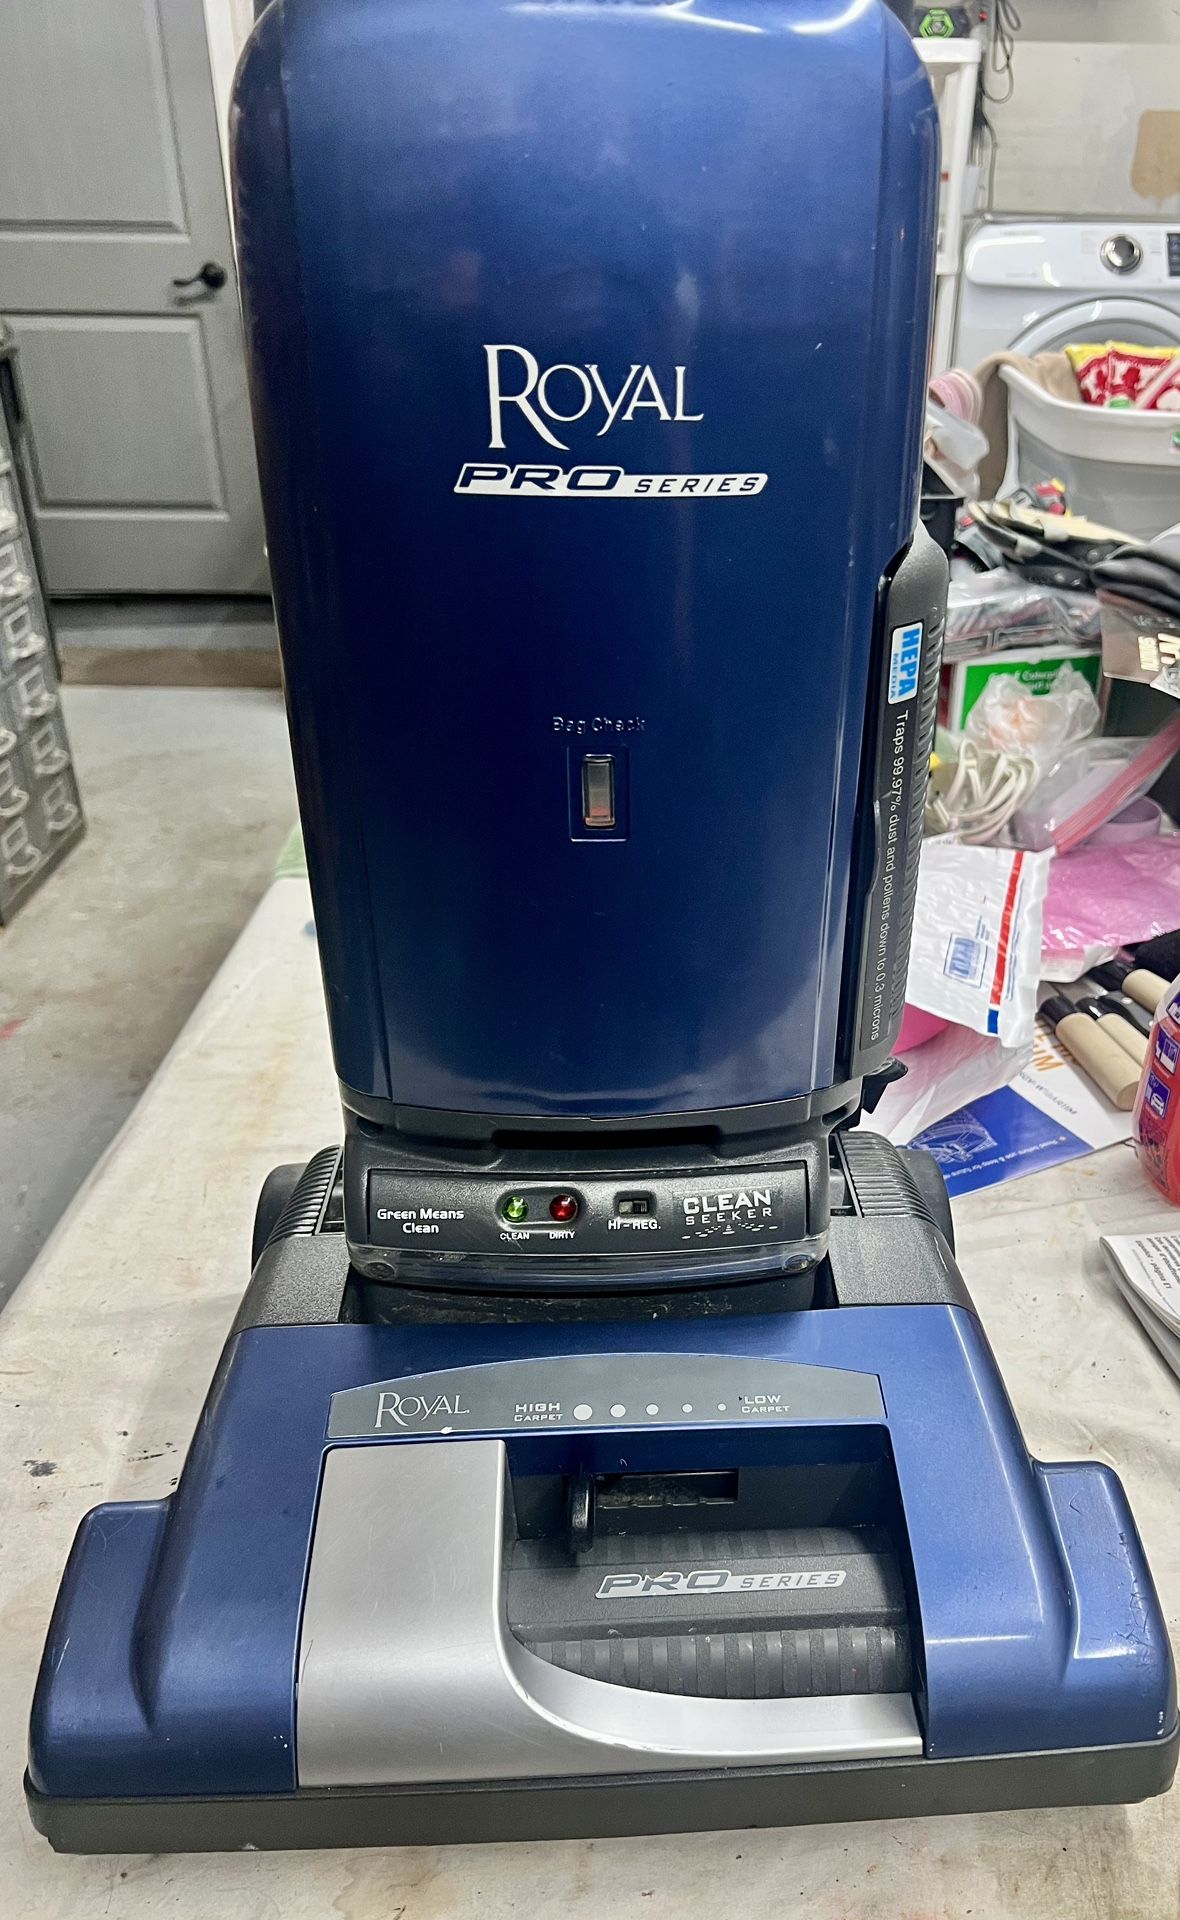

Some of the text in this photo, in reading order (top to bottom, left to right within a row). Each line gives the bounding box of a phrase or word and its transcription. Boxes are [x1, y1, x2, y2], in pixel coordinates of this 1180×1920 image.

[483, 344, 704, 451] ROYAL
[458, 465, 760, 494] PRO SERIES
[897, 627, 921, 698] HEPA
[889, 652, 899, 699] MEDIA
[552, 716, 645, 734] Bag Check
[870, 709, 909, 1042] Traps 99.97% dust and pollens down to 0.3 microns
[683, 1189, 772, 1215] CLEAN
[377, 1208, 465, 1220] Green Means
[685, 1207, 772, 1226] SEEKER
[402, 1222, 439, 1234] Clean
[500, 1232, 530, 1240] CLEAN
[549, 1231, 575, 1240] DIRTY
[515, 1402, 561, 1413] HIGH
[744, 1394, 781, 1404] LOW
[375, 1392, 470, 1428] ROYAL
[514, 1413, 563, 1422] CARPET
[741, 1405, 790, 1414] CARPET
[600, 1571, 840, 1594] PRO SERIES
